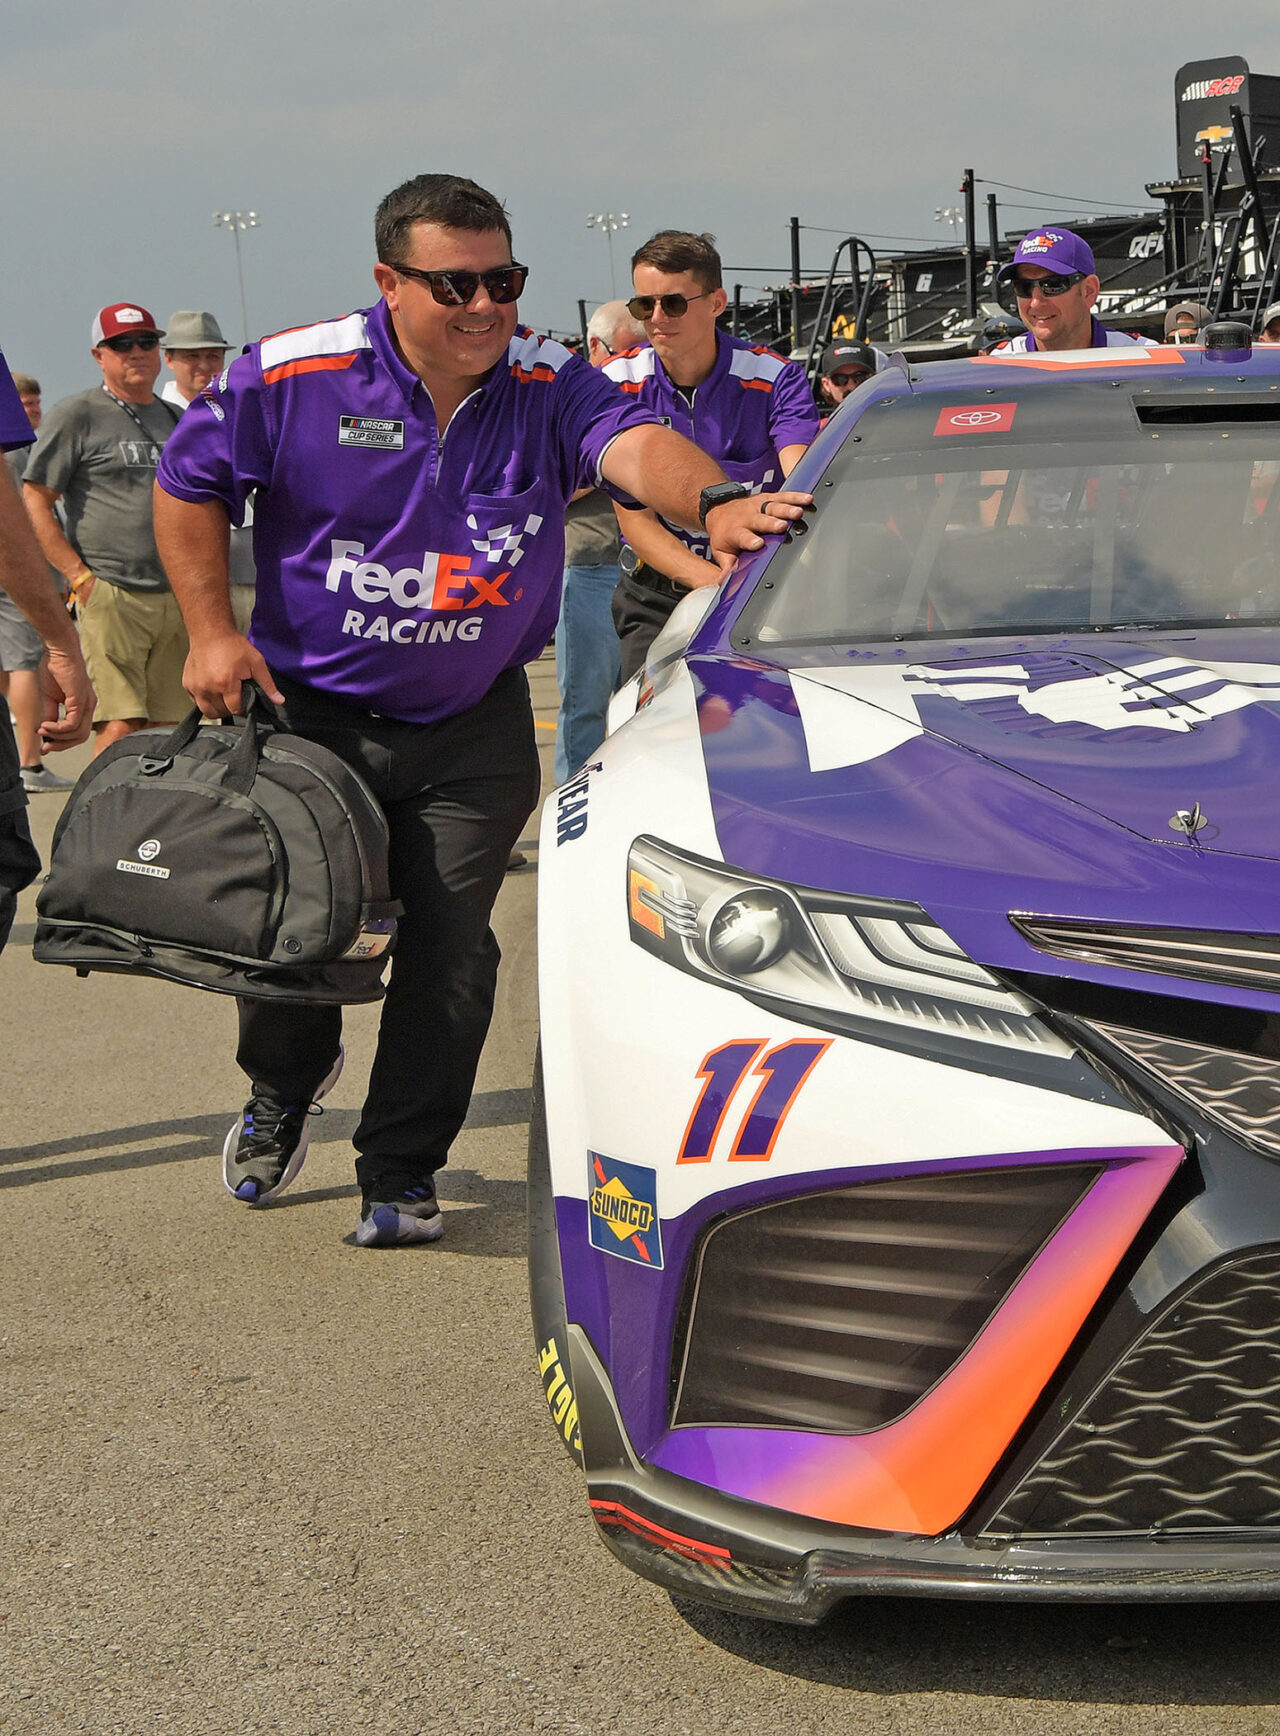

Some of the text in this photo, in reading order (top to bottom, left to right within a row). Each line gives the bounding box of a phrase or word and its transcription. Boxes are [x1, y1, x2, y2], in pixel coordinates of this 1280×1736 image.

[347, 431, 395, 443] CUP SERIES
[359, 420, 395, 432] NASCAR
[325, 539, 511, 611] FedEx
[341, 609, 483, 644] RACING
[119, 862, 168, 876] SCHUBERTH
[676, 1037, 836, 1165] 11
[592, 1190, 652, 1229] SUNOCO
